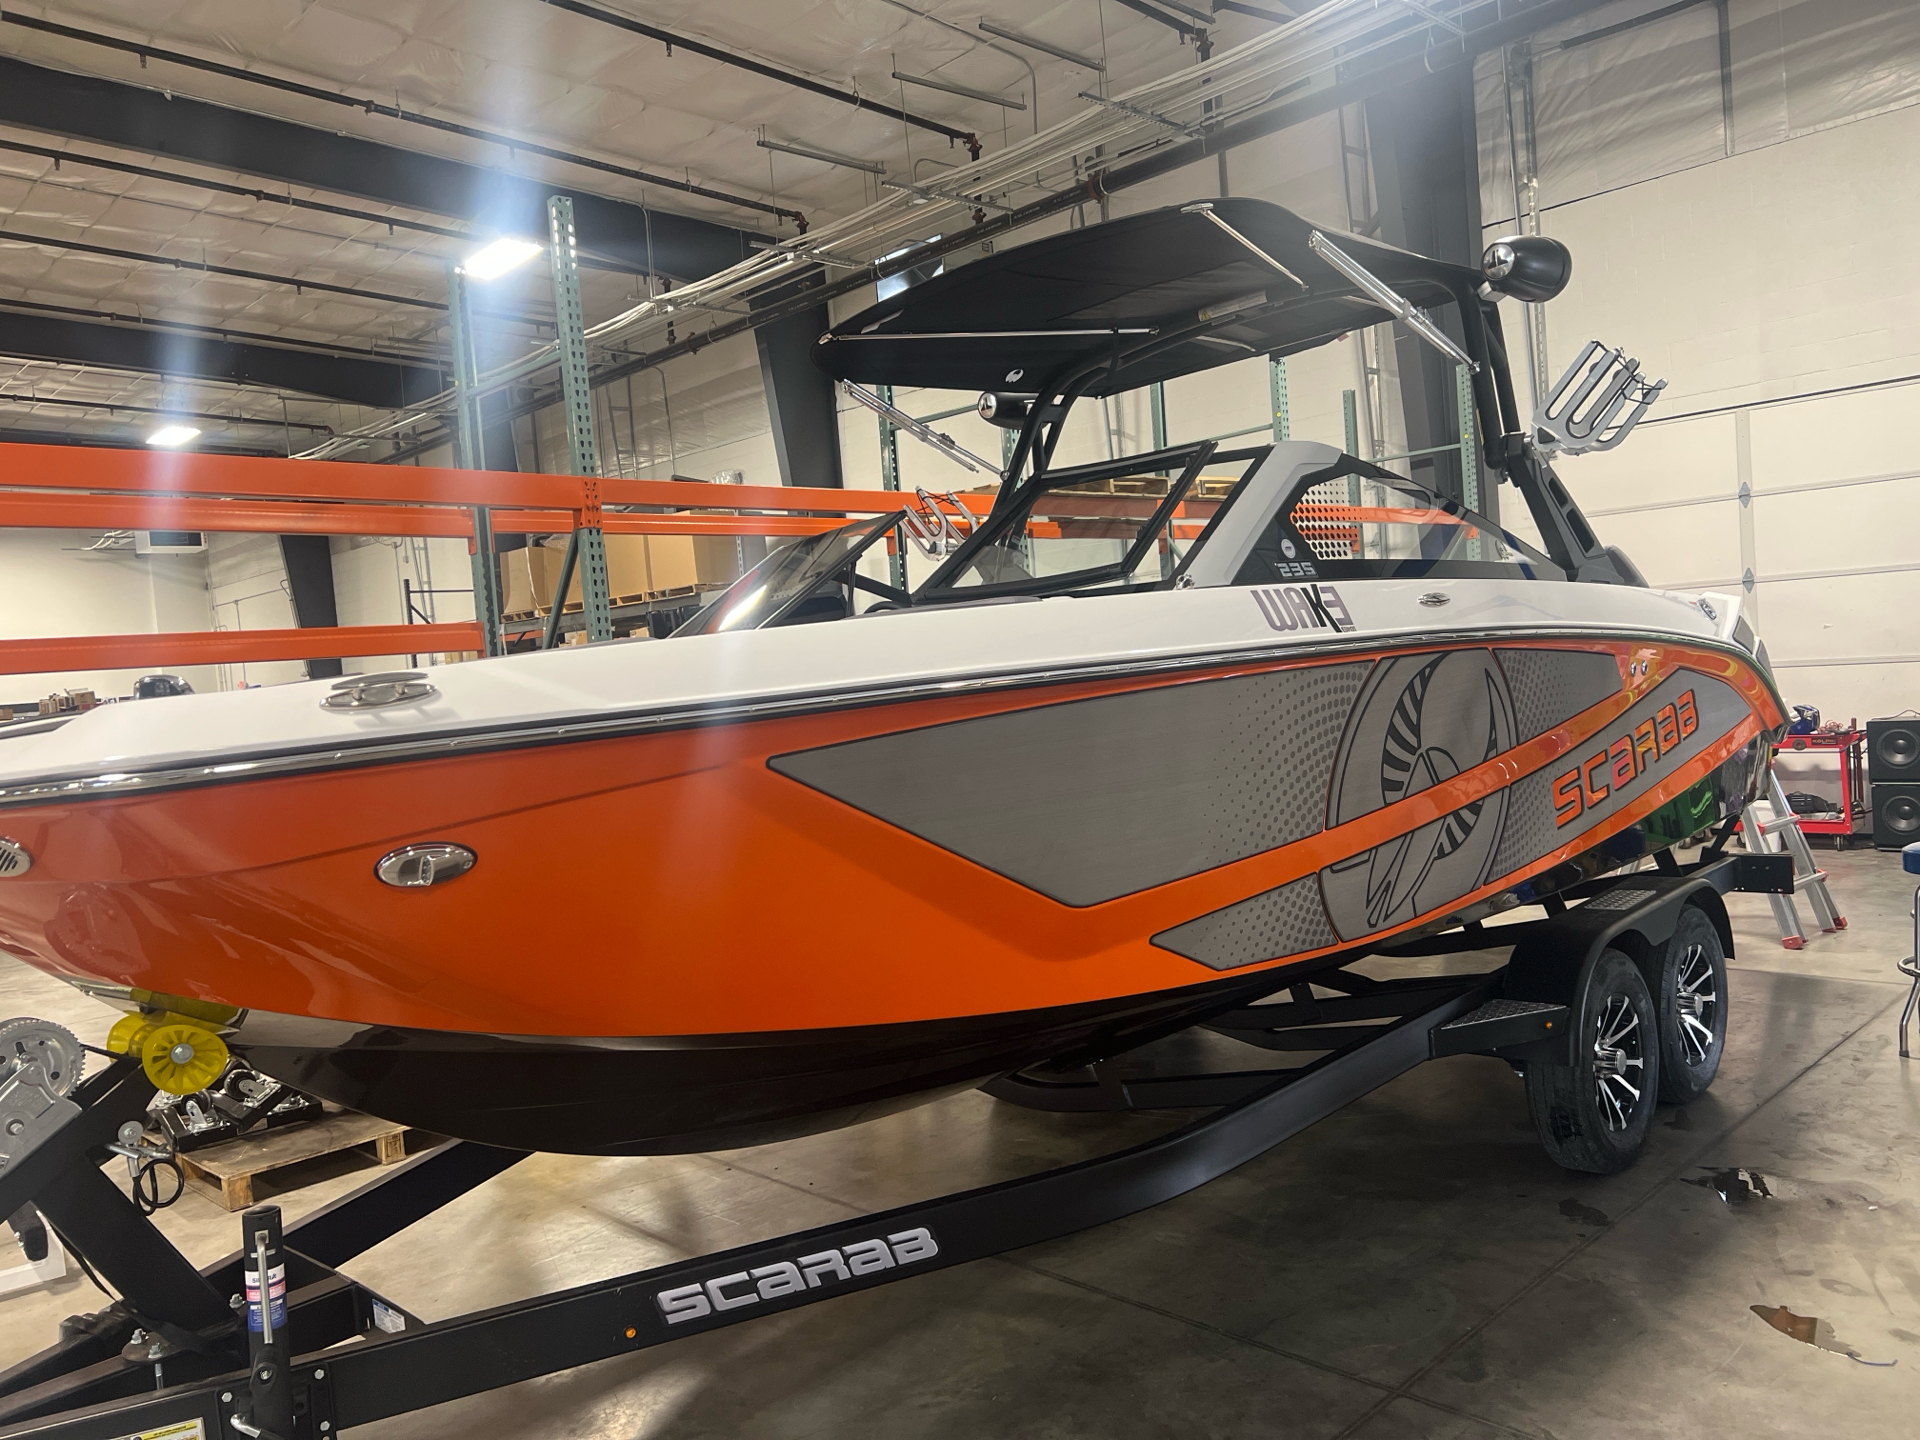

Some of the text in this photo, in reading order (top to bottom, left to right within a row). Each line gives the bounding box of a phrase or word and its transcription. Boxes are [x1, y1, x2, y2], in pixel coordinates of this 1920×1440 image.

[1276, 562, 1316, 577] 235
[1552, 689, 1699, 829] SCARAB
[657, 1227, 938, 1325] SCARAB
